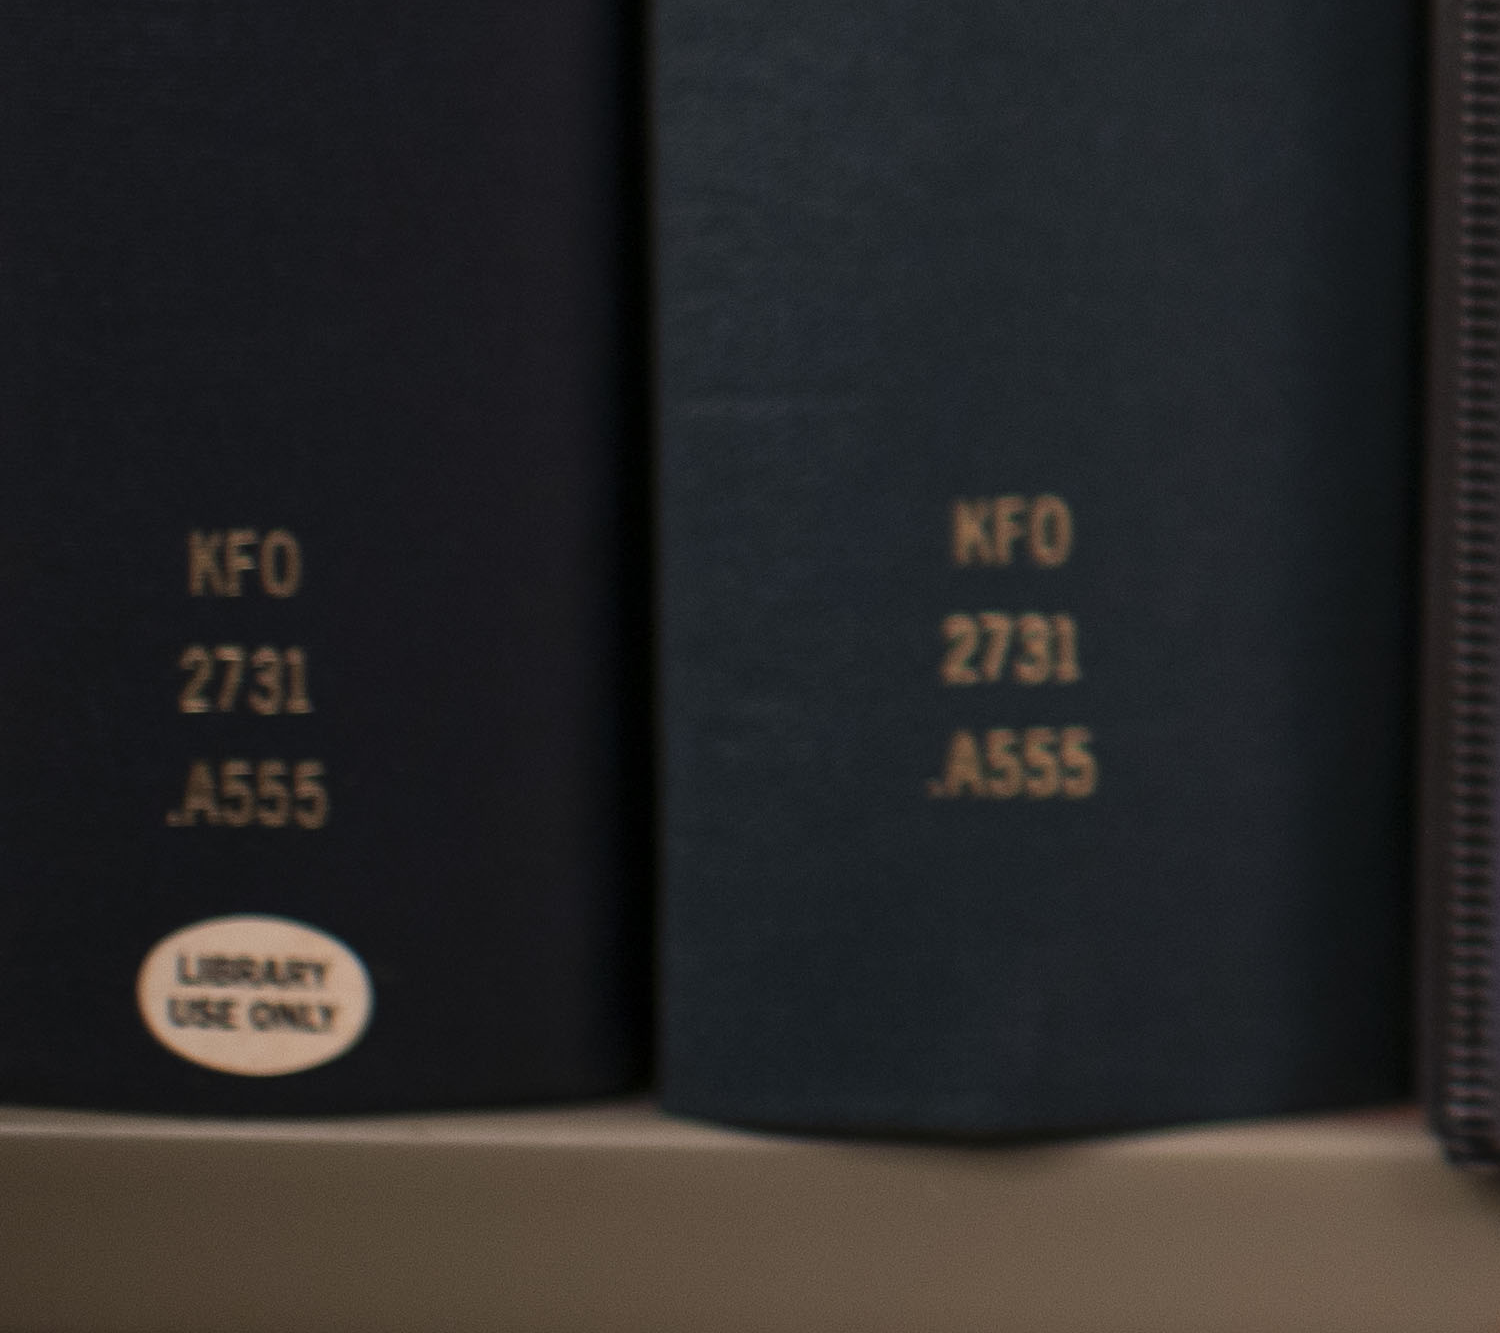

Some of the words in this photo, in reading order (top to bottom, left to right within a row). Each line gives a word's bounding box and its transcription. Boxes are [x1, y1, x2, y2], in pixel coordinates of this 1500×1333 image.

[188, 530, 301, 599] KFO
[952, 495, 1072, 569] KFO
[179, 647, 312, 715] 2731
[942, 614, 1081, 685] 2731
[167, 760, 329, 829] .A555
[929, 727, 1097, 800] .A555
[177, 954, 329, 991] LIBRARY
[167, 996, 237, 1032] USE
[249, 998, 340, 1035] ONLY
